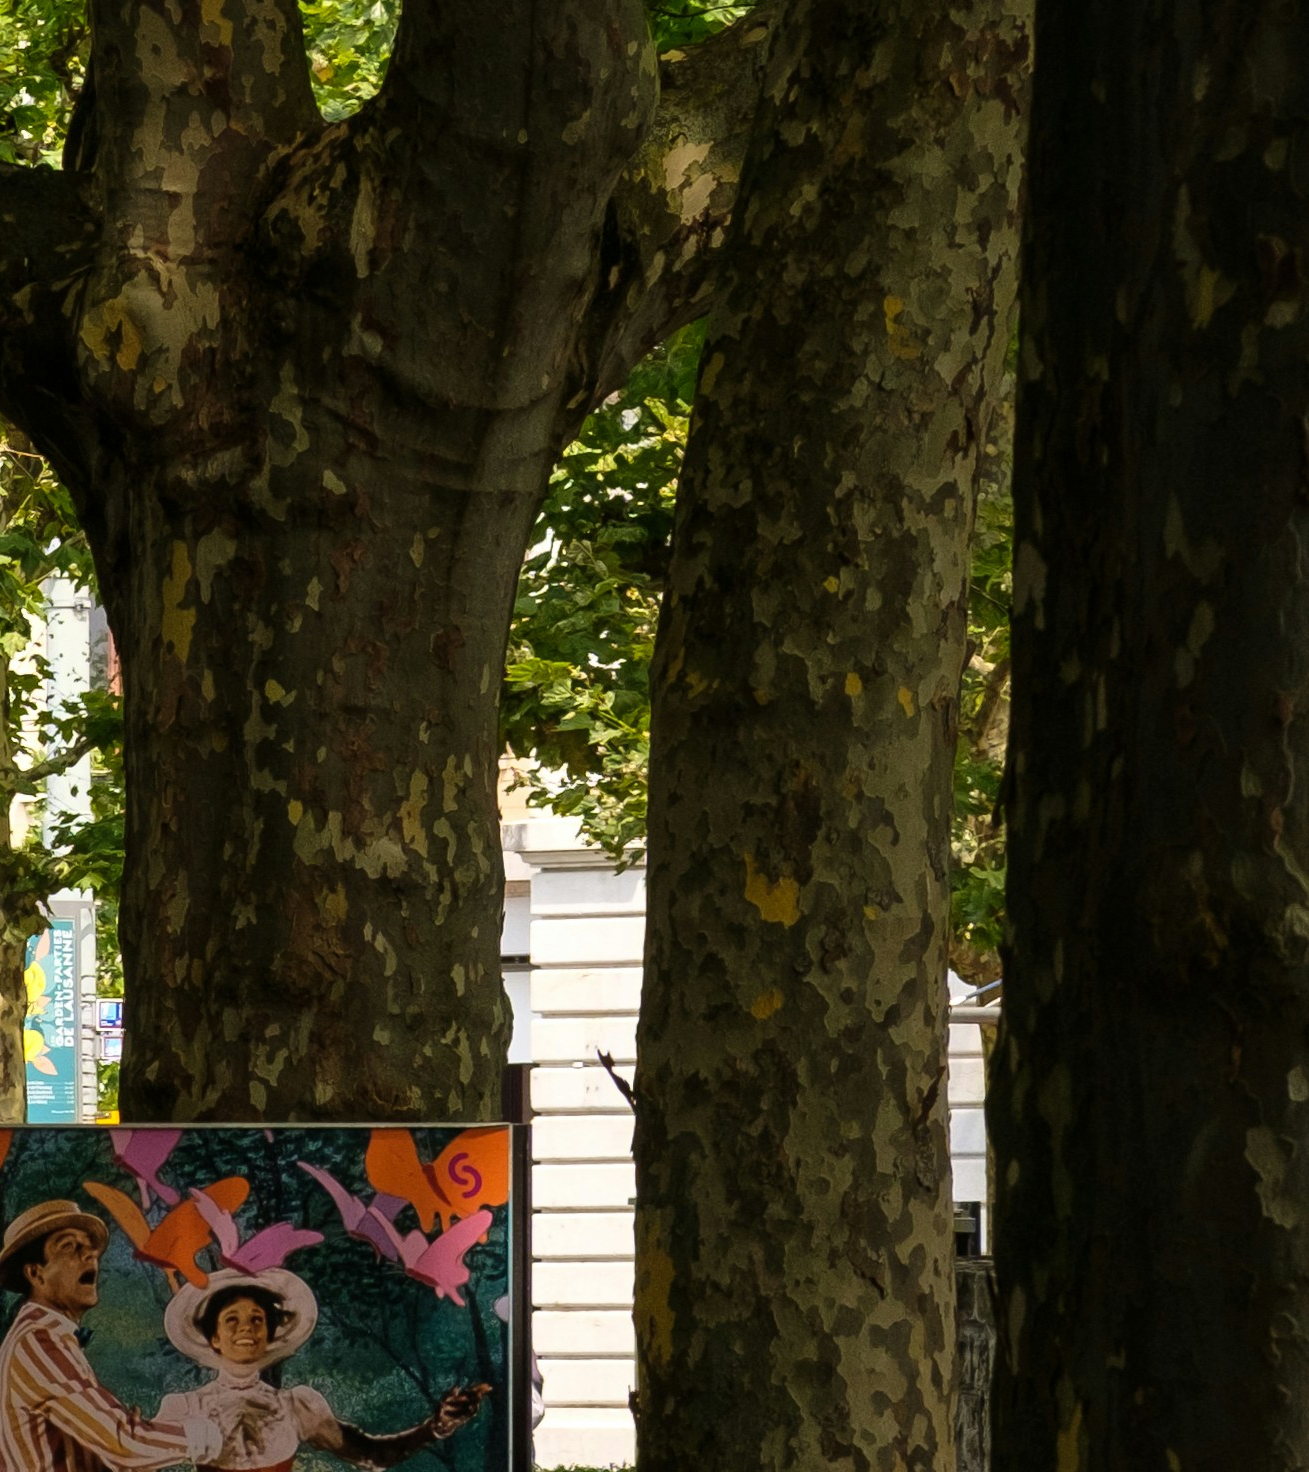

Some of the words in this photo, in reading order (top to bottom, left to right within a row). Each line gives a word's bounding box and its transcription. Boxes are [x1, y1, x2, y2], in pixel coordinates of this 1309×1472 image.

[54, 930, 64, 1047] GARDEN-PARTIES
[62, 929, 74, 1022] LAUSANNE
[64, 1027, 74, 1047] DE
